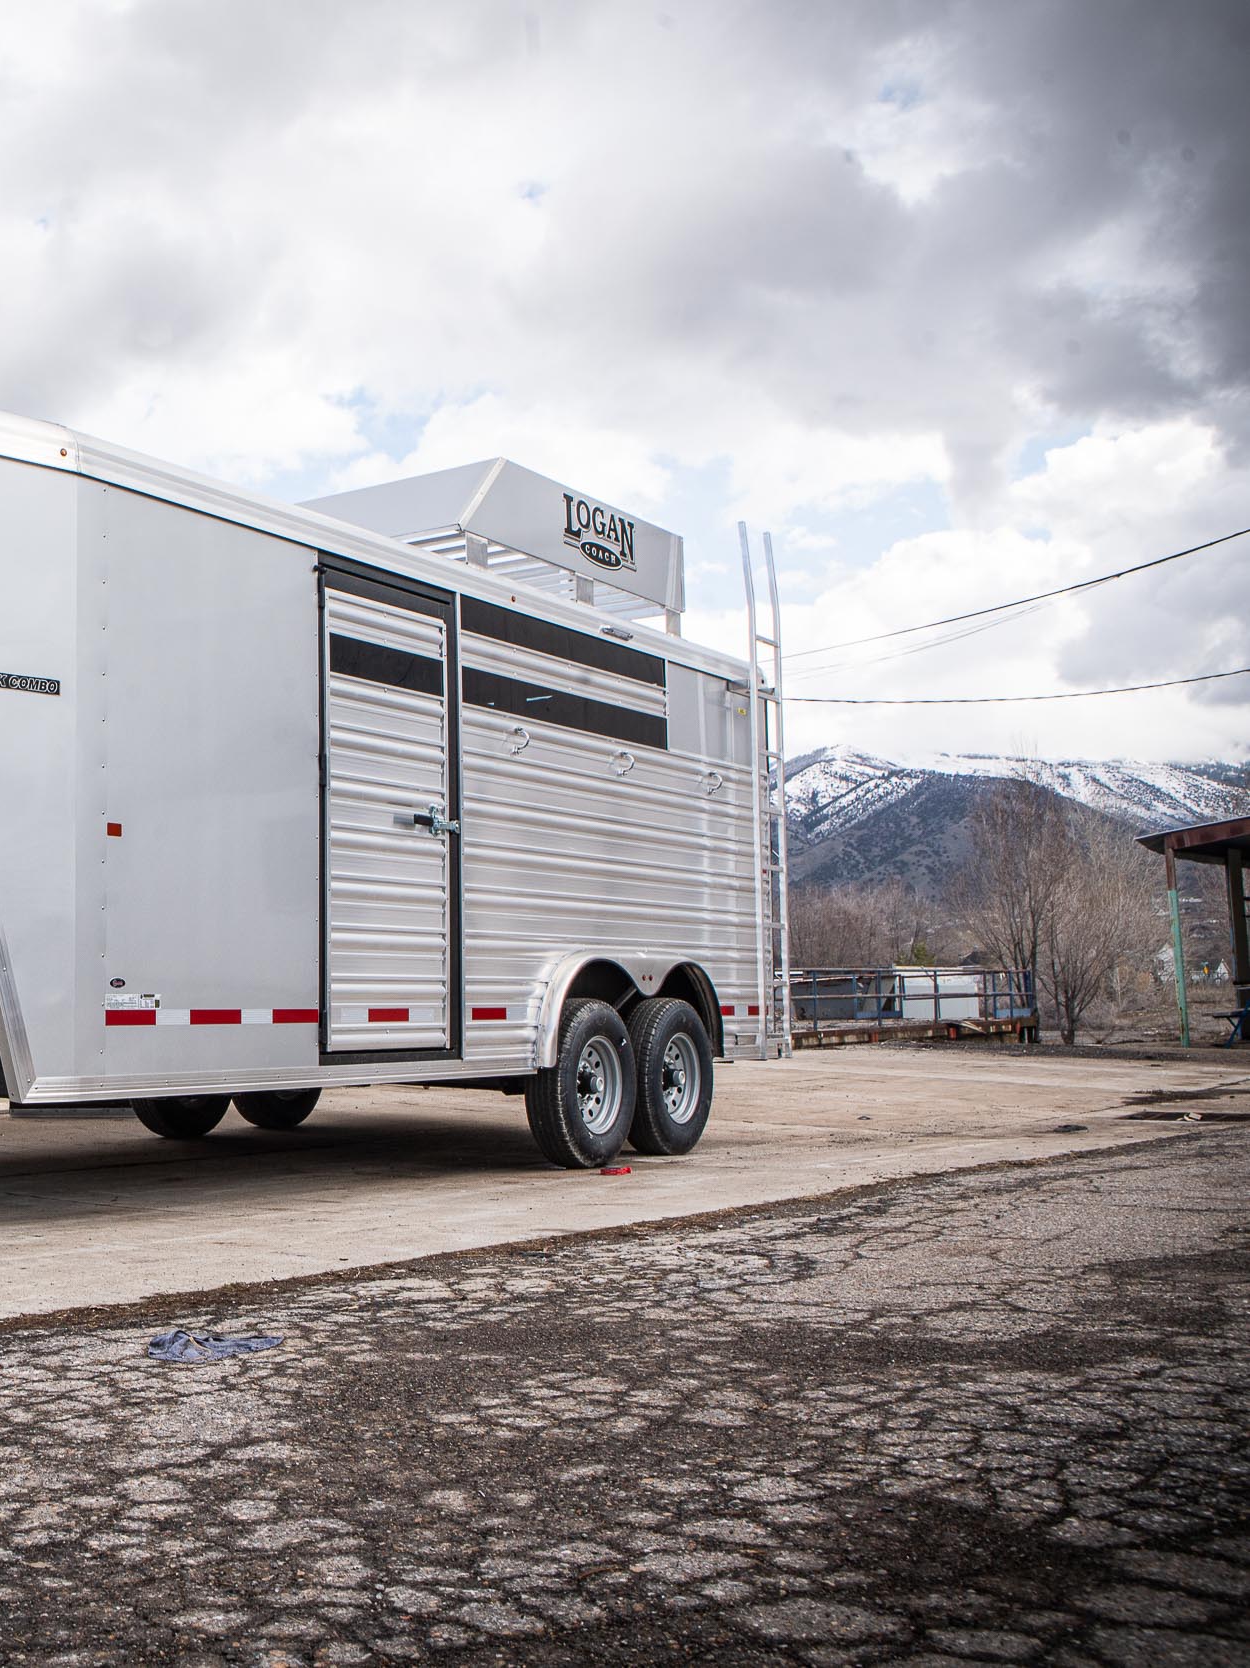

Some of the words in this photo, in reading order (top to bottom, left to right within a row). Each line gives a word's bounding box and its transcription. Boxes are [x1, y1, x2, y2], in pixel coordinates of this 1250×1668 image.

[563, 492, 635, 563] LOGAN
[585, 544, 617, 565] COACH
[9, 675, 59, 694] COMBO
